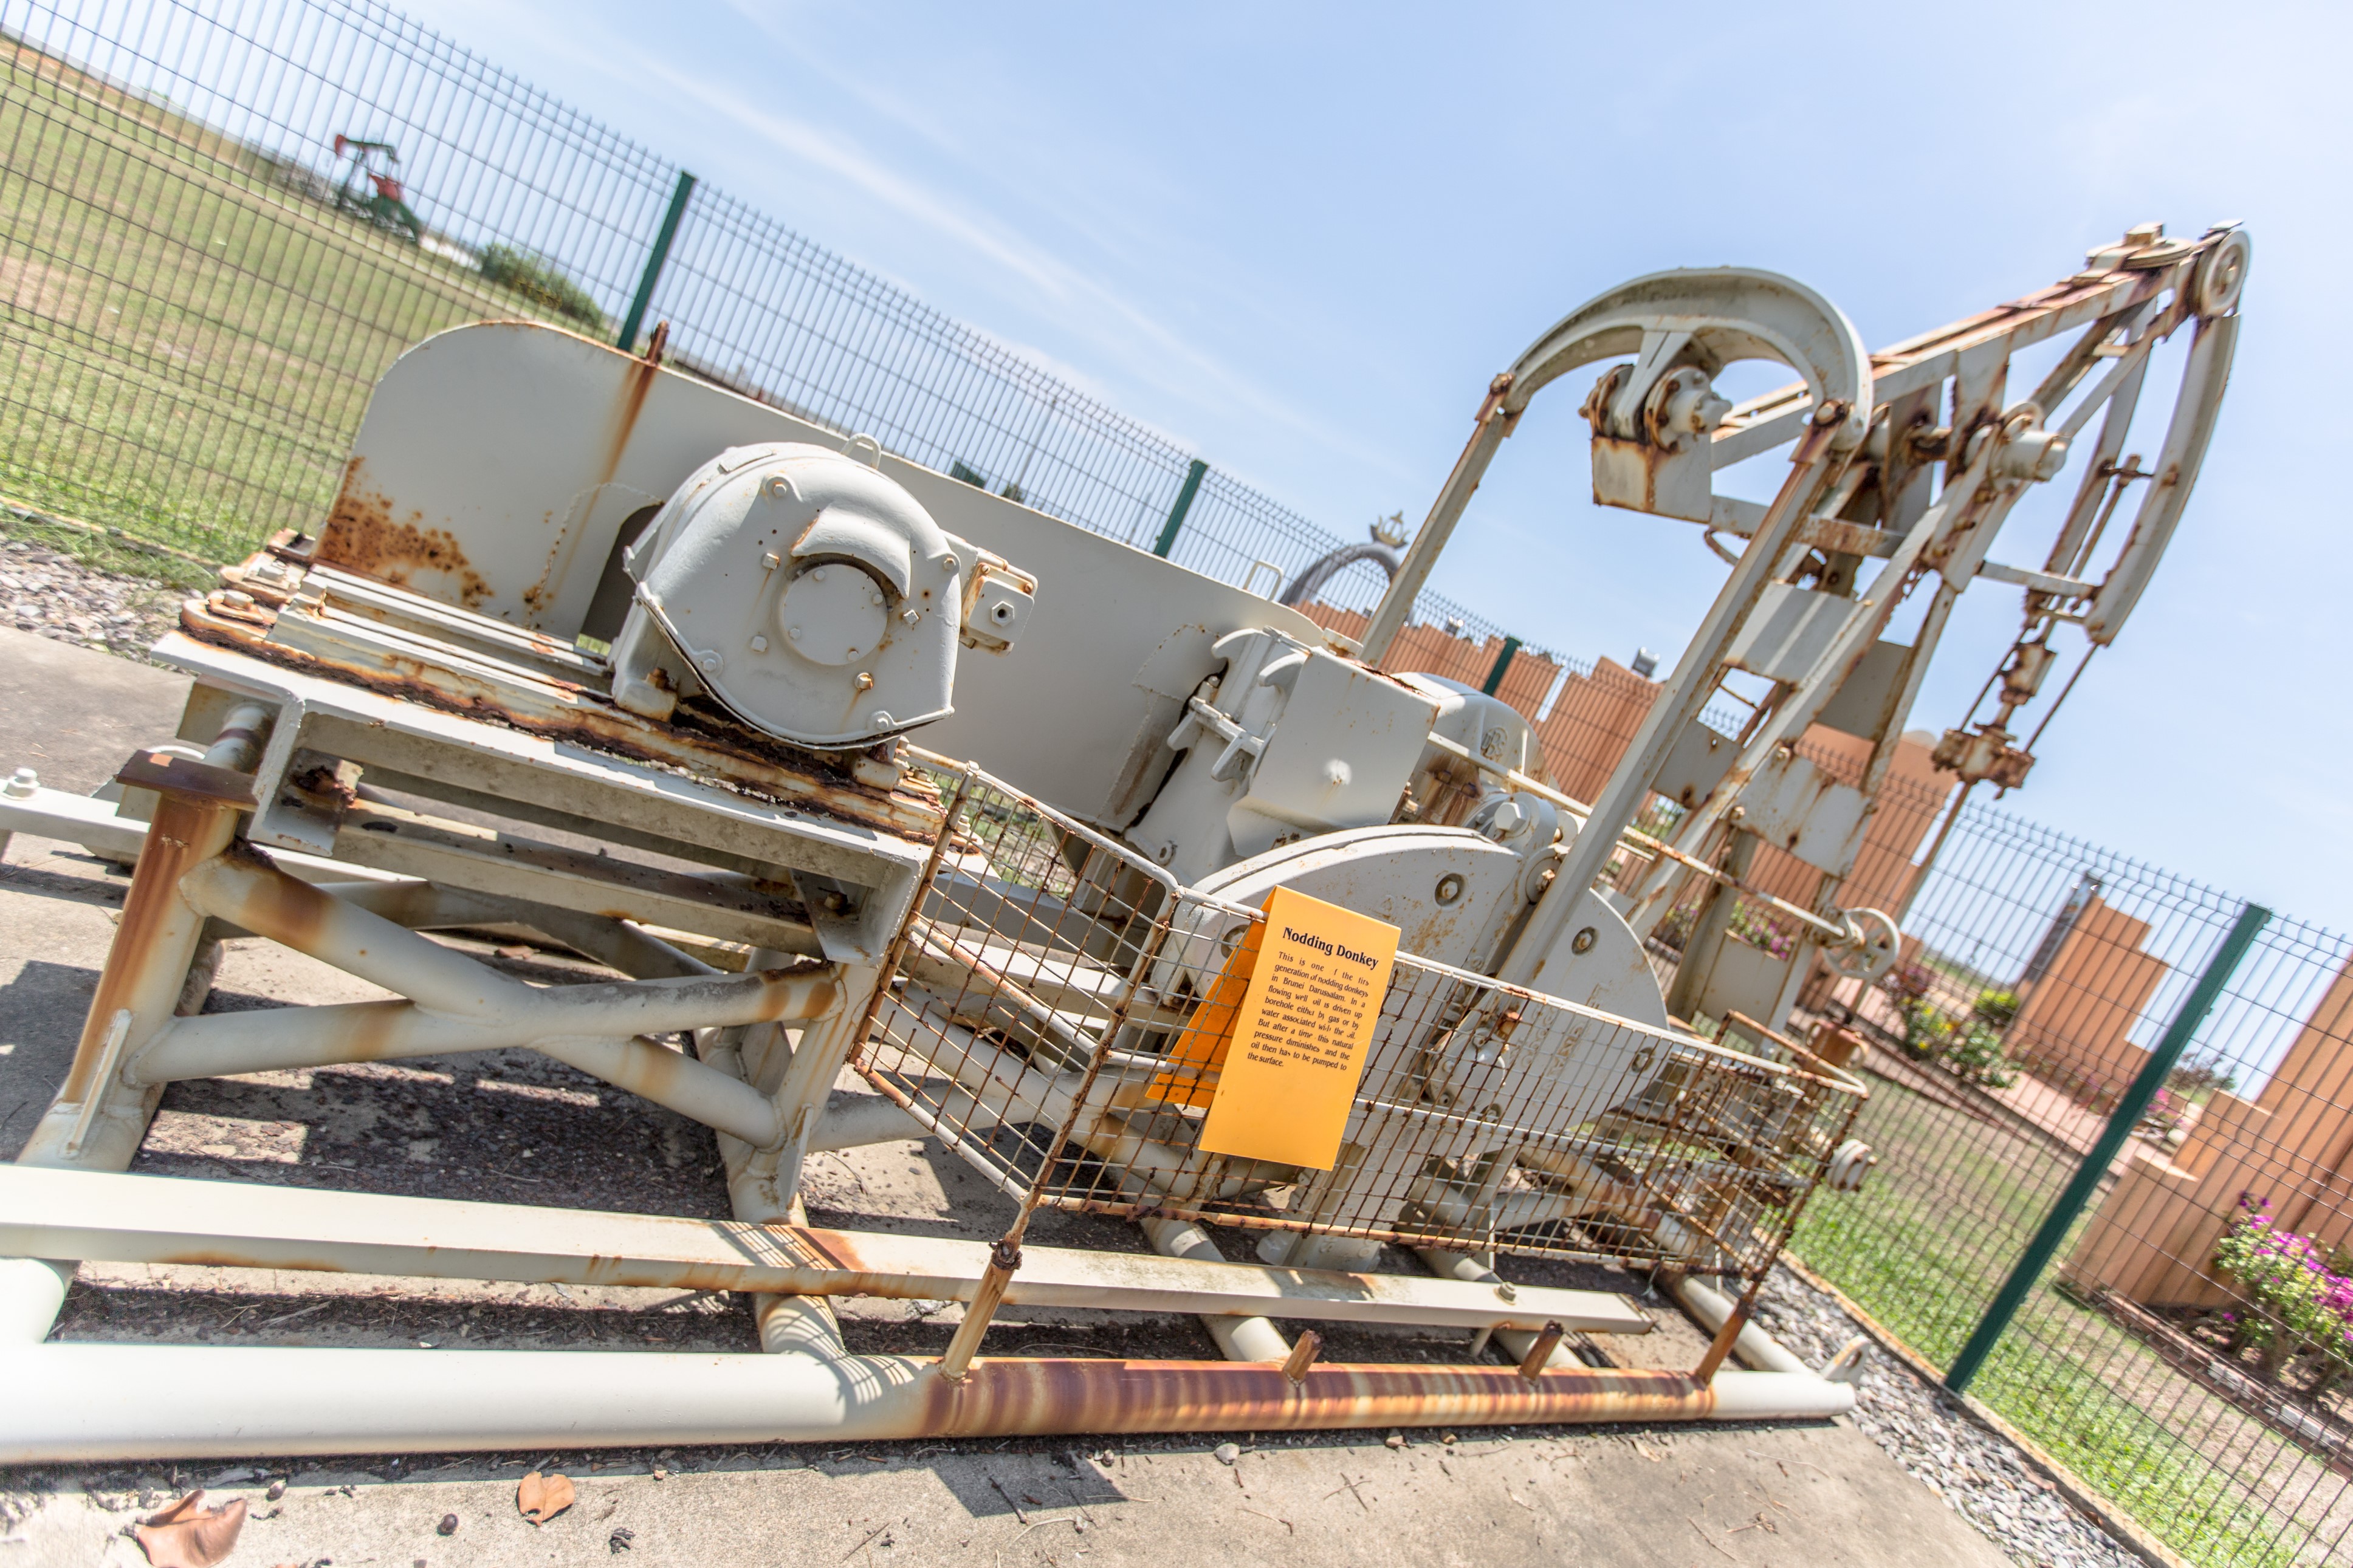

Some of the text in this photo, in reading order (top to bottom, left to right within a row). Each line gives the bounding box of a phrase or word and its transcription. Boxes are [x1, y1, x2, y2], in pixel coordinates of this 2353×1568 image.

[1282, 926, 1379, 971] Nodding Donkey
[1274, 964, 1310, 979] generation
[1317, 976, 1344, 991] nodding
[1279, 951, 1294, 962] This
[1299, 957, 1306, 967] is
[1311, 963, 1325, 972] one
[1342, 971, 1353, 981] the
[1268, 984, 1292, 1000] flowing
[1295, 993, 1308, 1002] well
[1332, 1004, 1352, 1015] driven
[1354, 1012, 1363, 1020] up
[1271, 973, 1279, 982] in
[1283, 977, 1305, 990] Brunei
[1308, 984, 1346, 1002] Darussalam.
[1350, 997, 1358, 1005] In
[1262, 1008, 1280, 1018] water
[1282, 1014, 1316, 1028] associated
[1334, 1027, 1345, 1036] the
[1265, 996, 1294, 1010] borehole
[1327, 1015, 1340, 1024] gas
[1352, 1021, 1359, 1031] by
[1253, 1031, 1283, 1043] pressure
[1324, 1049, 1338, 1057] and
[1339, 1052, 1350, 1061] the
[1257, 1018, 1270, 1028] But
[1272, 1022, 1289, 1033] after
[1298, 1029, 1313, 1038] time
[1317, 1034, 1330, 1044] this
[1331, 1039, 1354, 1050] natural
[1247, 1052, 1284, 1067] the surface.
[1262, 1043, 1277, 1054] then
[1302, 1053, 1311, 1062] be
[1311, 1057, 1339, 1069] pumped
